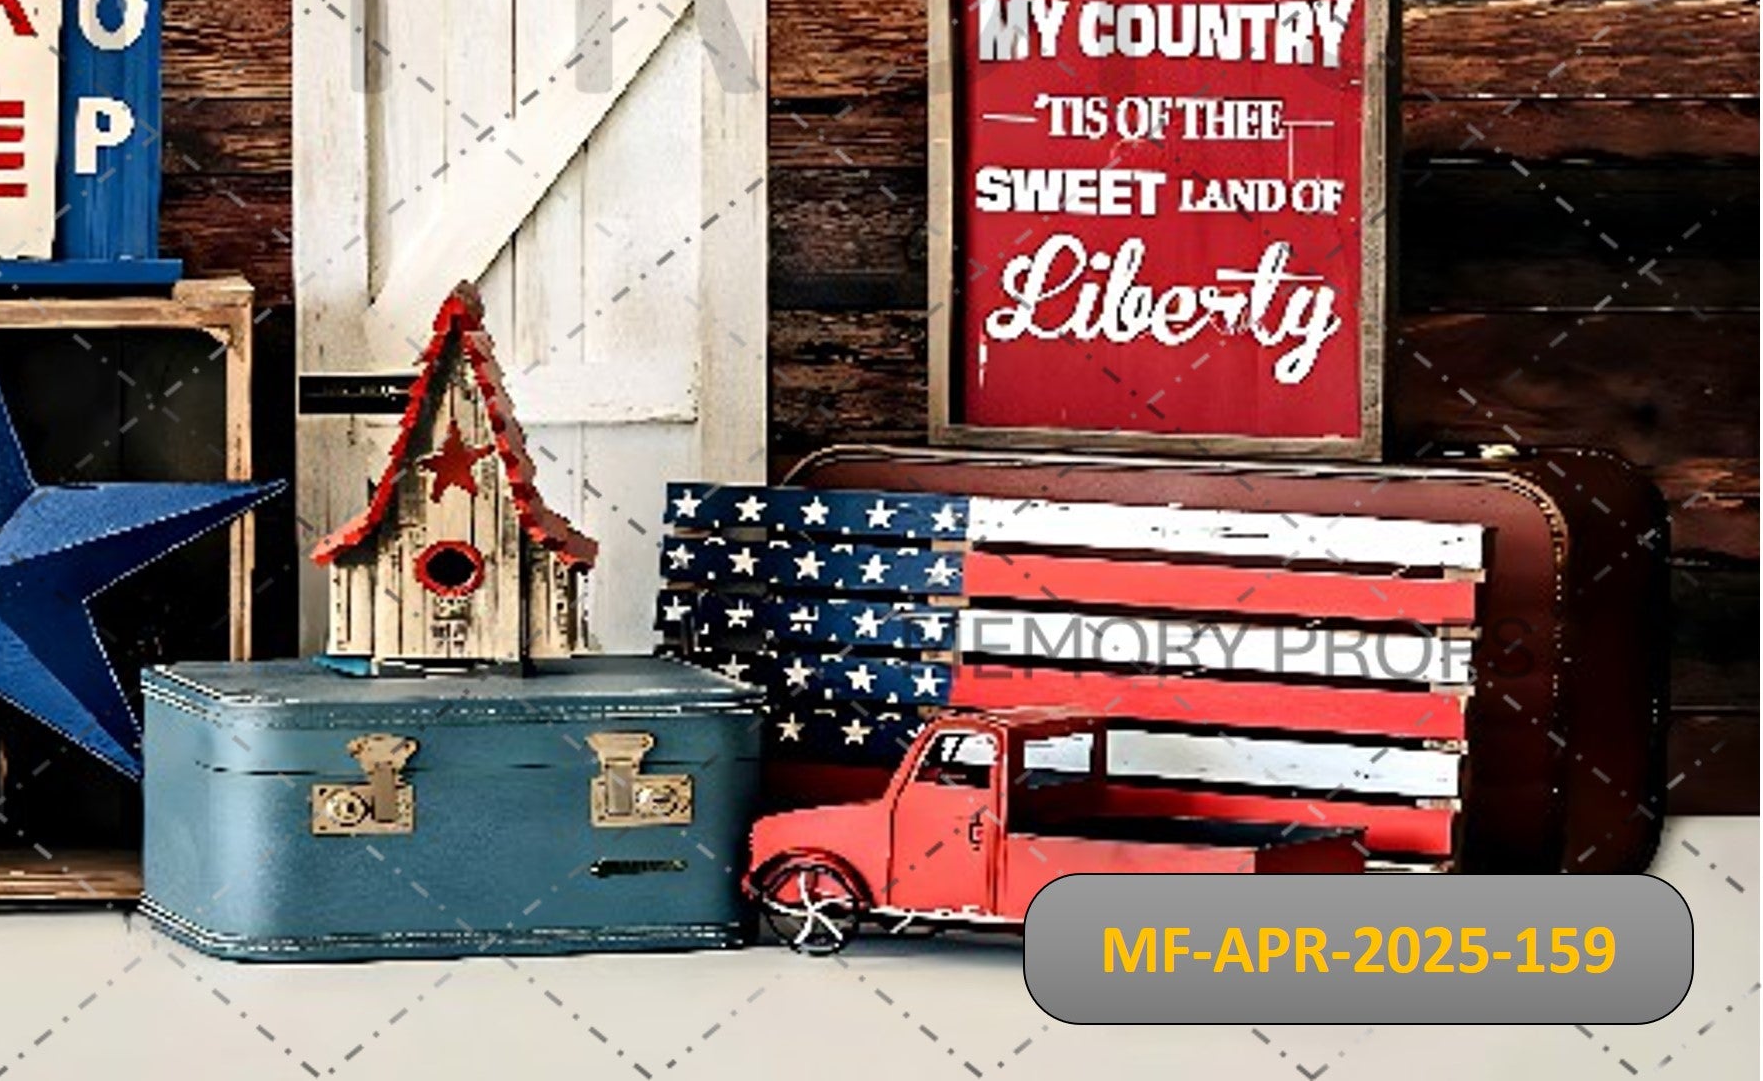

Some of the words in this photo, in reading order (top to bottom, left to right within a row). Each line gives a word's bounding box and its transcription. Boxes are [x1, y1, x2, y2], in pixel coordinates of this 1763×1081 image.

[1114, 96, 1172, 140] OF
[1174, 96, 1287, 141] THEE
[975, 165, 1167, 216] SWEET
[1177, 178, 1287, 213] LAND
[1290, 176, 1345, 214] OF
[985, 232, 1342, 386] Liberty
